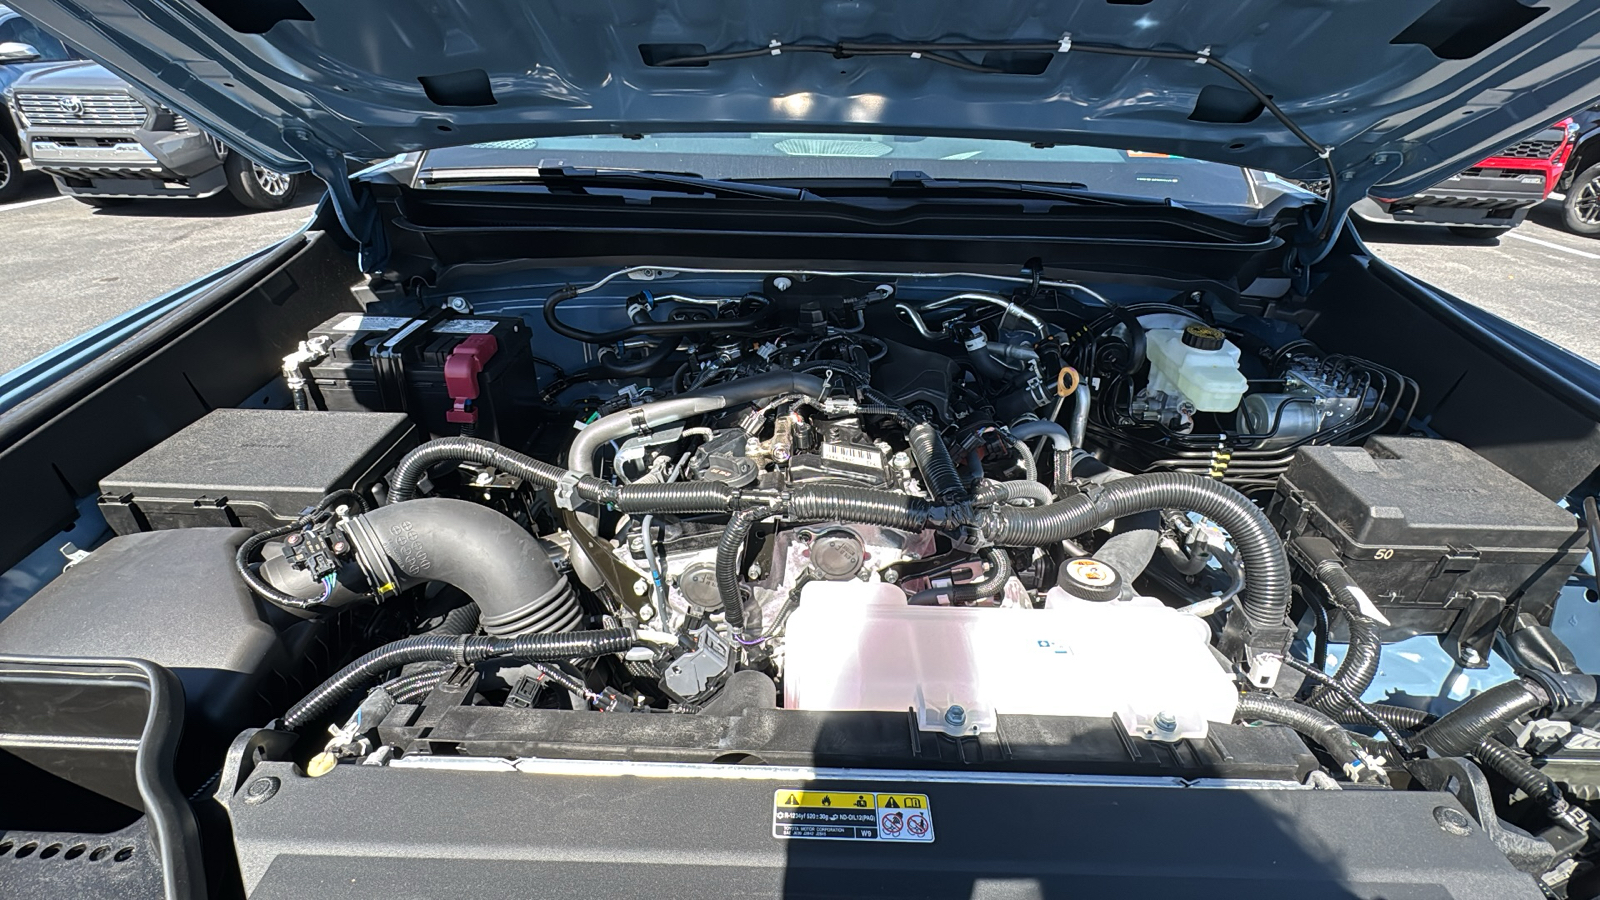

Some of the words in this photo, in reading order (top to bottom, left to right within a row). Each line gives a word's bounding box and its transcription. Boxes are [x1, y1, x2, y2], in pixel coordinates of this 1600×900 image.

[1374, 549, 1394, 560] 50
[784, 812, 806, 820] R-1234yf
[861, 829, 872, 837] W9
